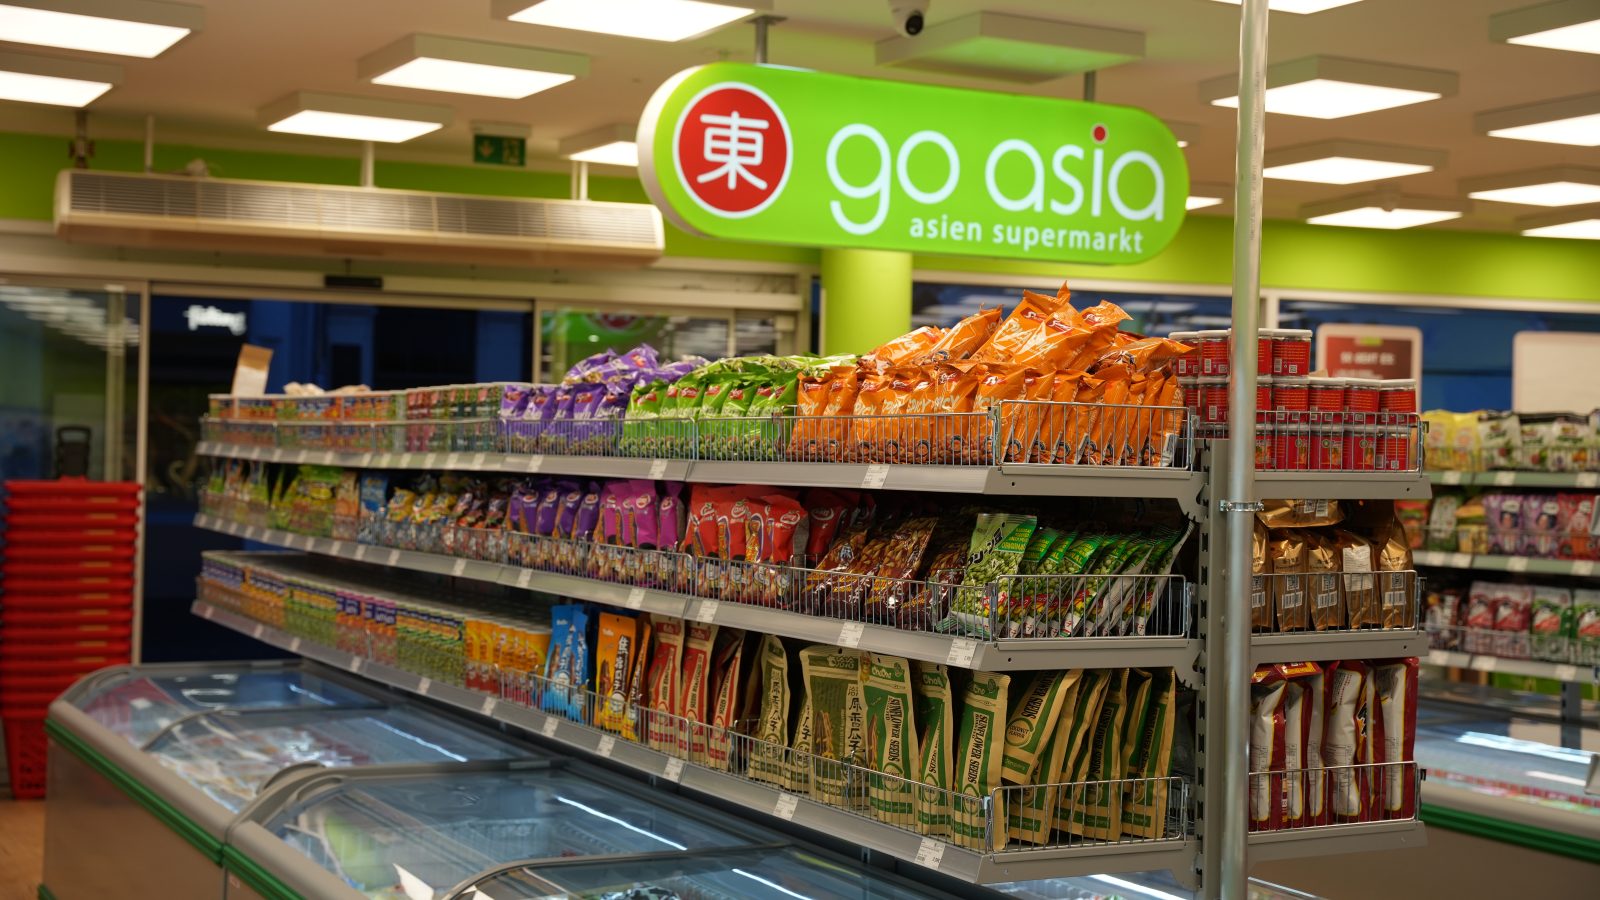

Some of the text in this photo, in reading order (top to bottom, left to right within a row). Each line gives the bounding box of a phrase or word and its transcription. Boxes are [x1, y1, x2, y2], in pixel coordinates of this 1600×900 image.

[697, 111, 770, 189] 東
[826, 123, 1165, 235] go asia
[909, 213, 1143, 253] asien supermarkt
[891, 698, 902, 738] SUNFLOWER
[1021, 692, 1043, 720] SEEDS
[888, 739, 900, 761] SEEDS
[968, 713, 988, 784] SUNFLOWER SEEDS
